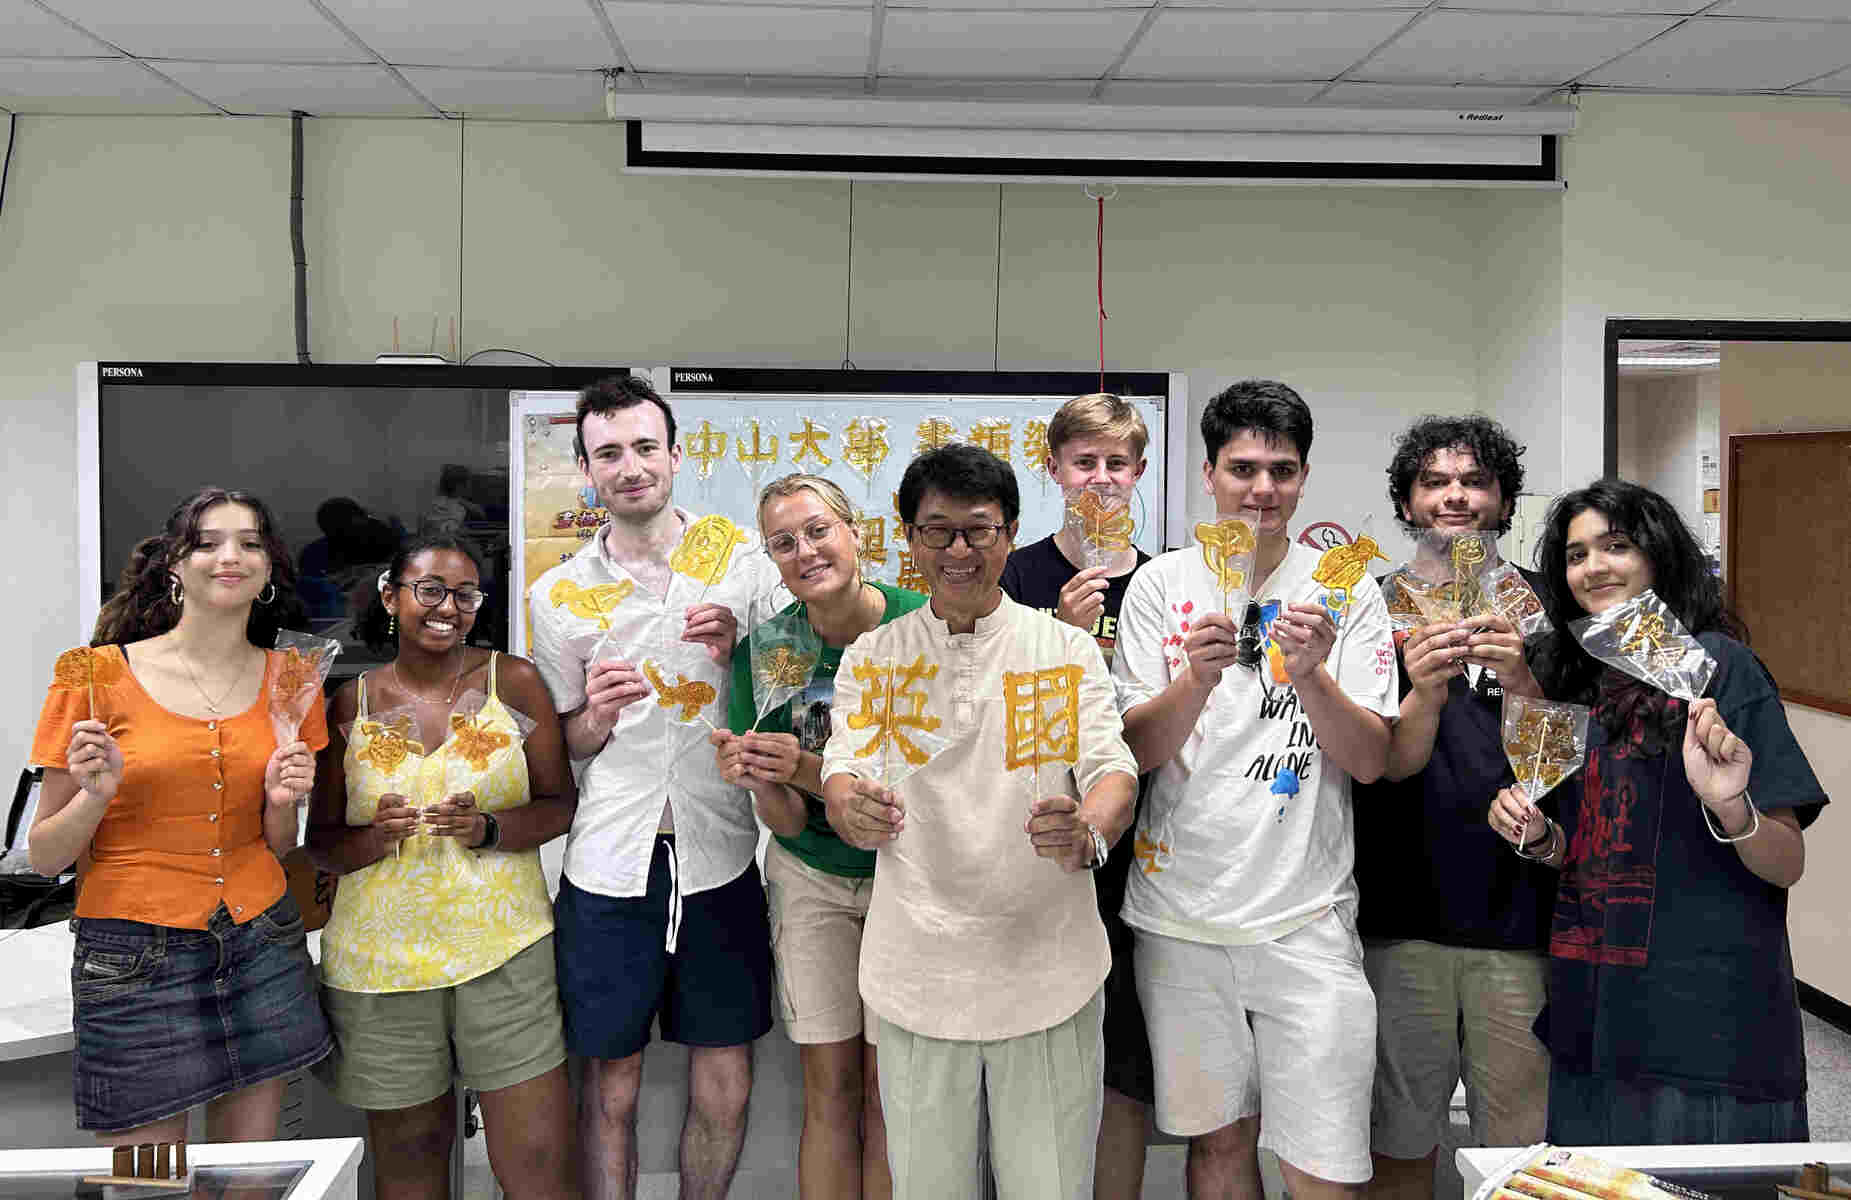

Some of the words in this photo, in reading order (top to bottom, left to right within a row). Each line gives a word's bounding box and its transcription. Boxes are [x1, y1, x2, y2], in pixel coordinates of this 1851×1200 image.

[102, 367, 144, 377] PERSONA
[674, 372, 714, 383] PERSONA
[1259, 687, 1304, 721] WA
